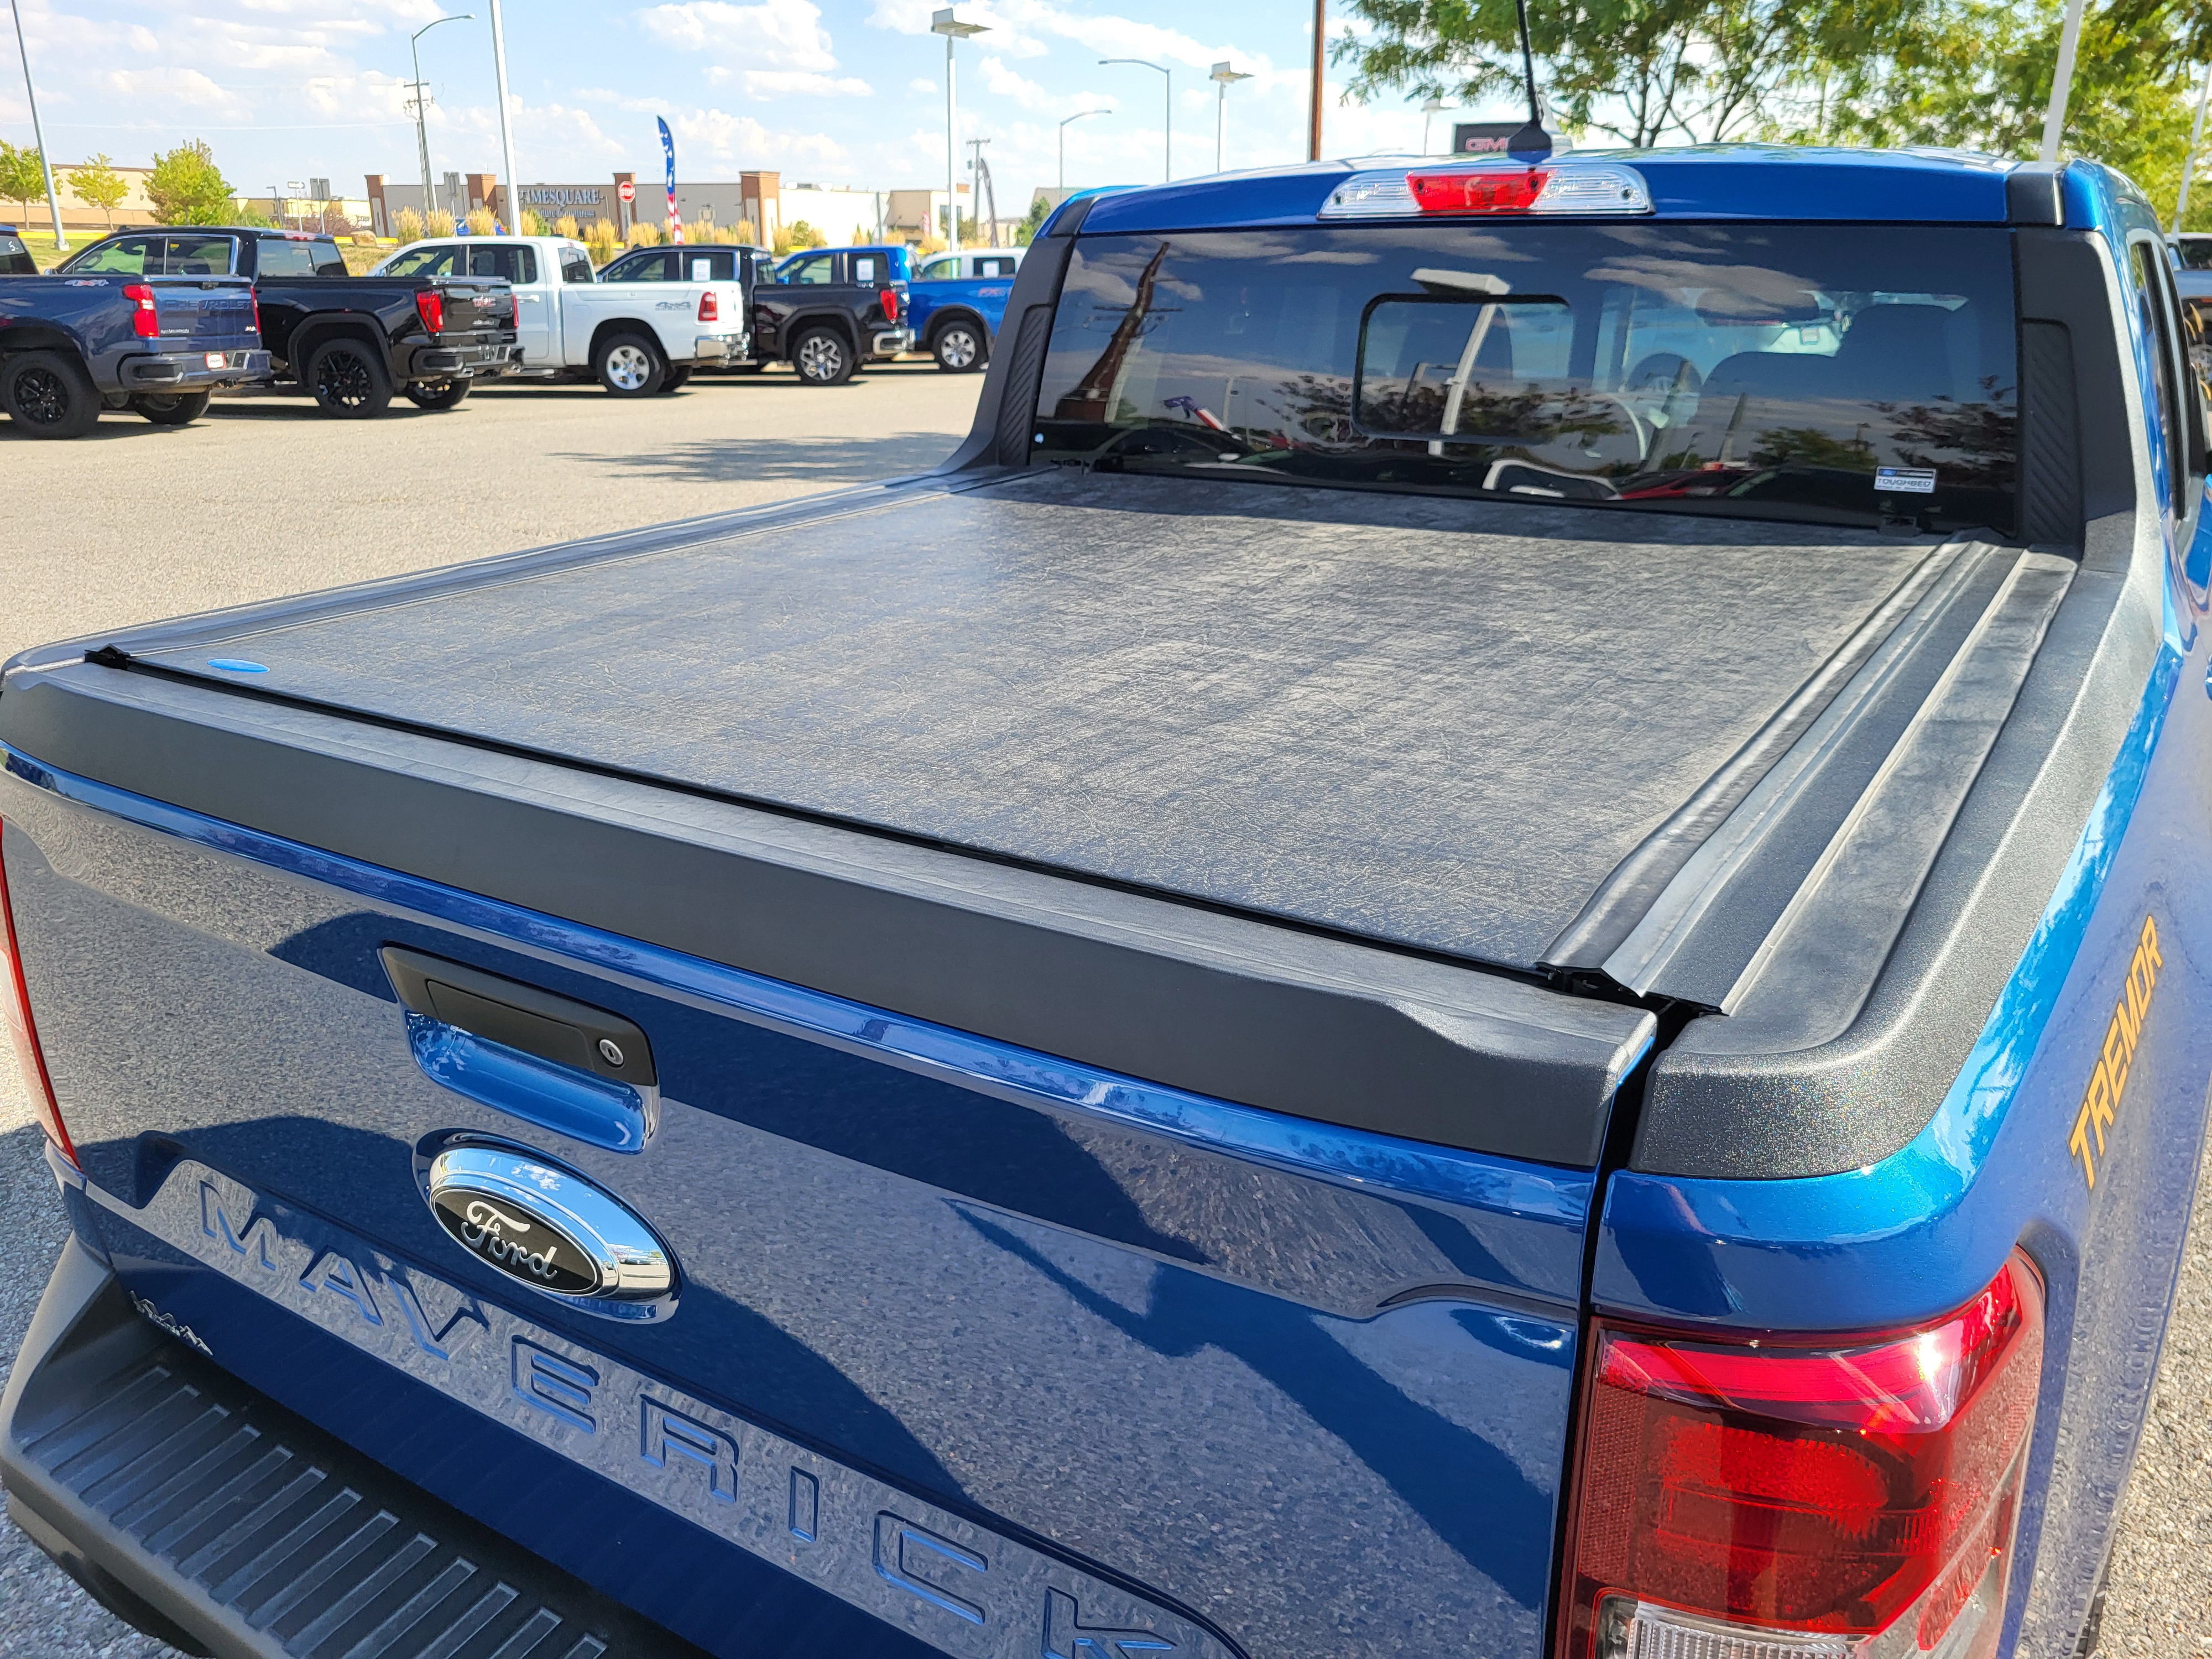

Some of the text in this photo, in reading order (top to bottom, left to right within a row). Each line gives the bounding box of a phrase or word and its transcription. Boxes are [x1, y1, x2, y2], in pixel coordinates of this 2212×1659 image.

[1466, 136, 1508, 152] GM
[519, 189, 599, 206] TIMESQUARE
[620, 187, 634, 197] STOP
[165, 299, 251, 311] CHEVROLET
[1878, 478, 1931, 487] TOUGHBED
[2070, 915, 2163, 1190] TREMOR
[461, 1201, 557, 1280] Ford
[199, 1180, 1178, 1659] MAVERICK
